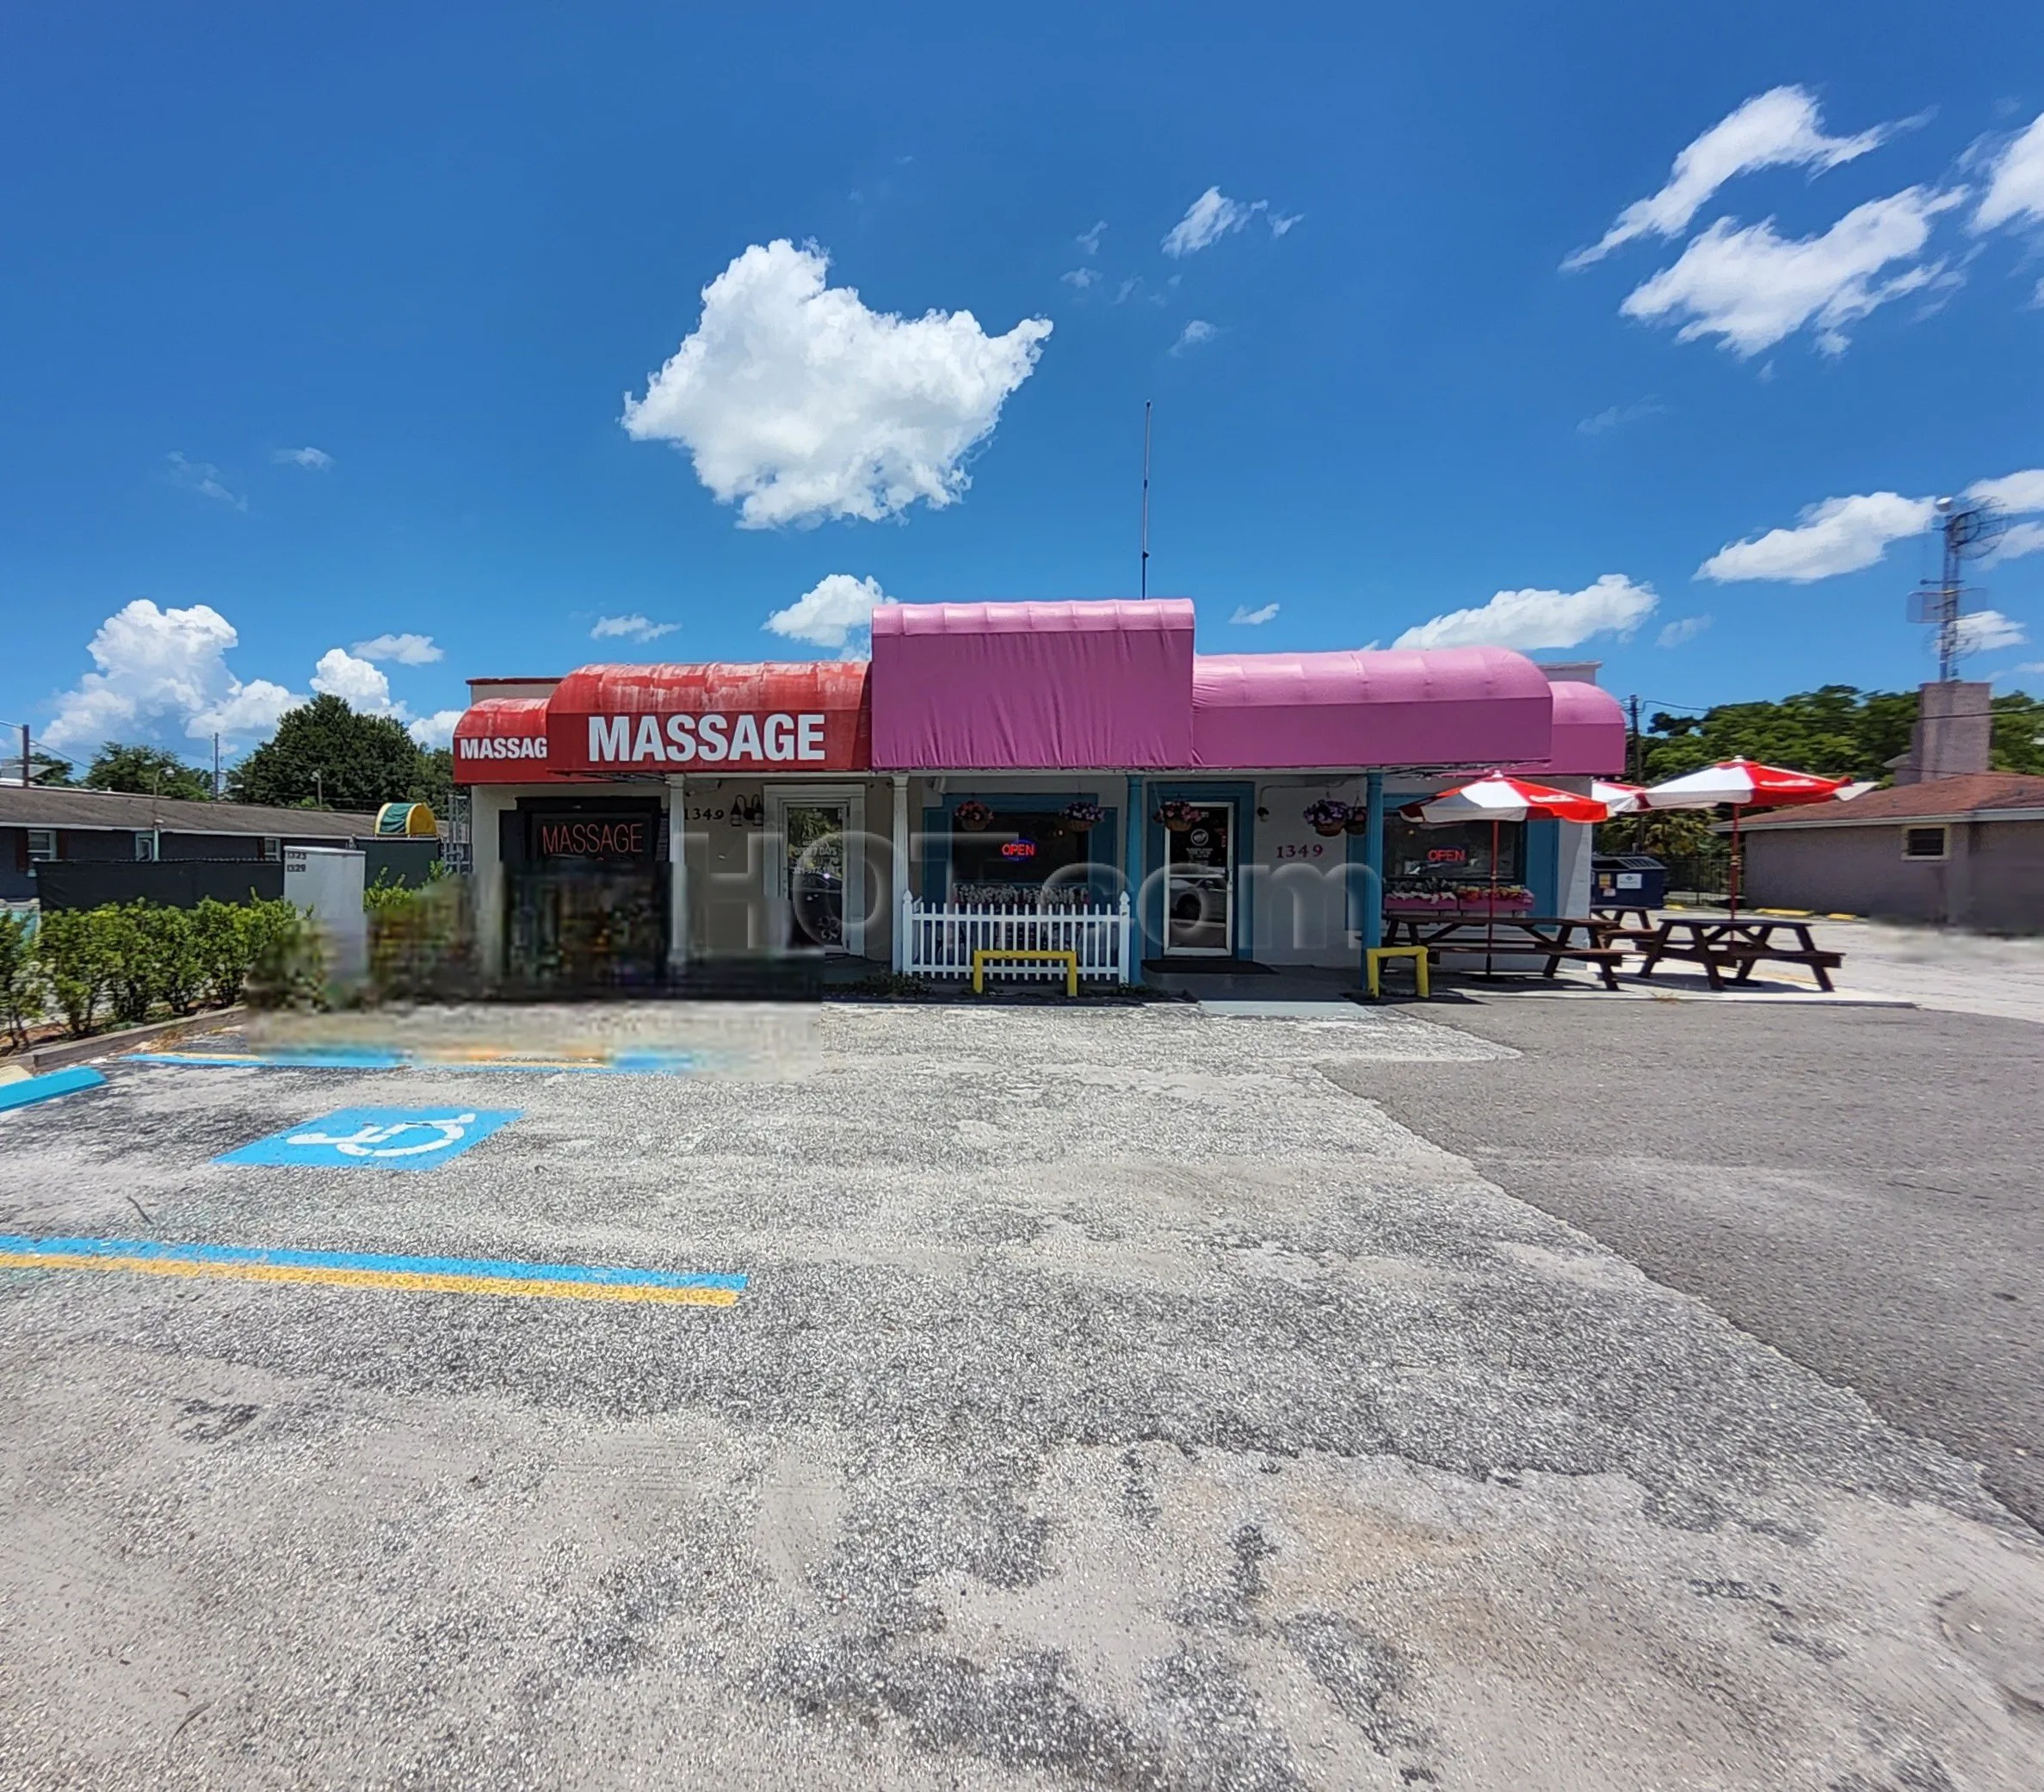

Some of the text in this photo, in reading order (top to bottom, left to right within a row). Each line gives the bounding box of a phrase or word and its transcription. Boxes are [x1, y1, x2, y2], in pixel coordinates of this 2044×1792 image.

[588, 714, 826, 762] MASSAGE
[684, 807, 725, 820] 1349
[542, 823, 643, 854] MASSAGE
[1002, 843, 1034, 856] OPEN
[1276, 844, 1324, 858] 1349
[1428, 849, 1466, 862] OPEN
